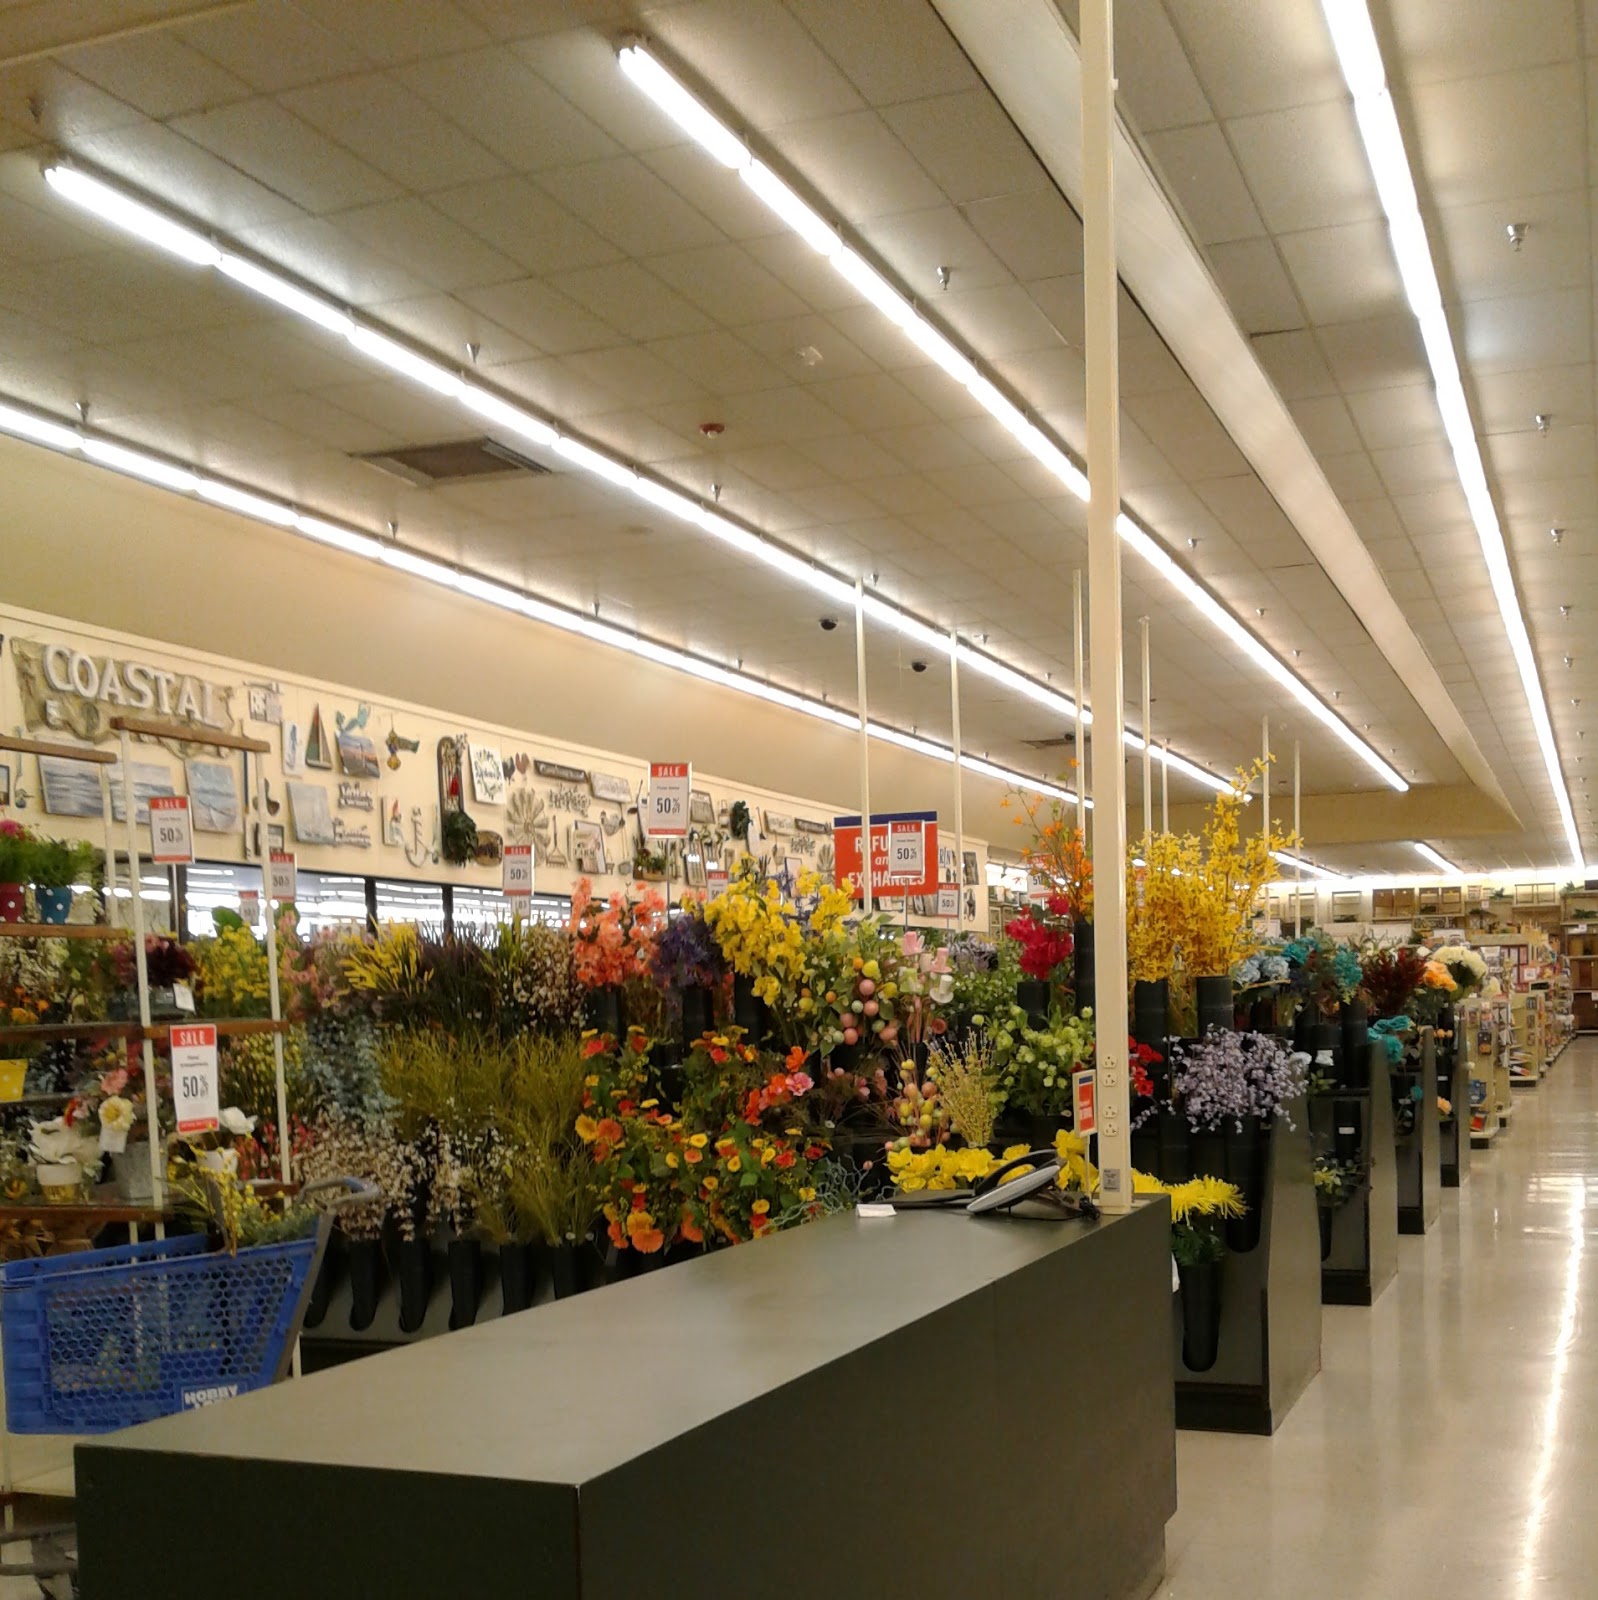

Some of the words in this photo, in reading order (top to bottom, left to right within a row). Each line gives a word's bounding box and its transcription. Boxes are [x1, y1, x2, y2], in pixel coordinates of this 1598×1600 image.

[44, 645, 224, 729] COASTAL
[657, 766, 680, 777] SALE
[158, 799, 180, 809] SALE
[897, 824, 915, 832] SALE
[875, 856, 888, 865] an
[848, 869, 925, 888] EXHANES
[180, 1030, 206, 1045] SALE
[184, 1385, 238, 1405] HOBBY
